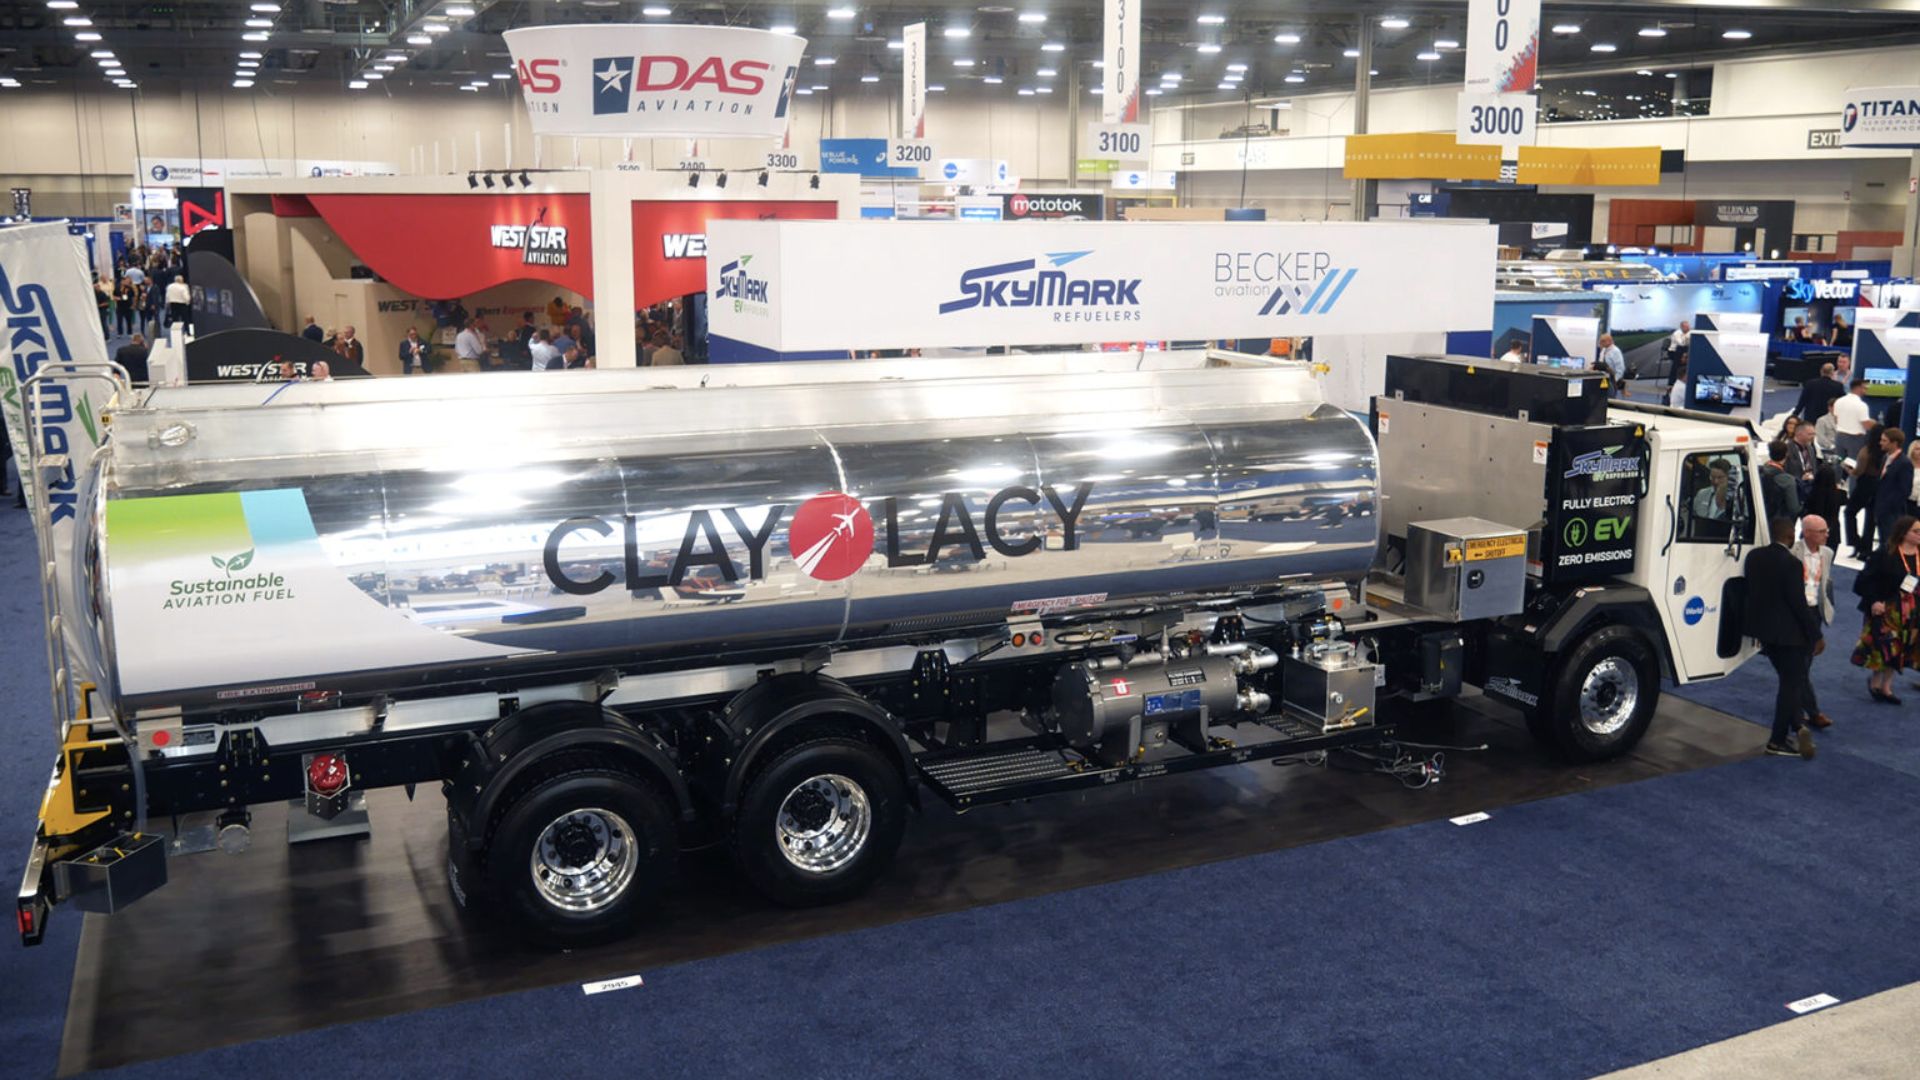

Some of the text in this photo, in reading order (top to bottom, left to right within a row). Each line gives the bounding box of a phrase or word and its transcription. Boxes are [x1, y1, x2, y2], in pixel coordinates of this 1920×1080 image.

[636, 56, 769, 96] DAS
[637, 100, 754, 115] AVIATION
[1861, 100, 1920, 117] TITAN
[1470, 106, 1524, 134] 3000
[1099, 132, 1140, 153] 3100
[767, 154, 797, 168] 3300
[896, 145, 932, 162] 3200
[1013, 198, 1082, 212] mototok
[490, 225, 567, 250] WEST STAR
[527, 252, 568, 266] AVIATION
[1215, 252, 1331, 282] BECKER
[1215, 284, 1271, 297] aviation
[1054, 311, 1142, 323] REFUELERS
[217, 362, 307, 377] WEST STR
[1563, 494, 1635, 511] FULLY ELECTRIC
[1594, 515, 1631, 541] EV
[544, 482, 1095, 595] CLAY LACY
[1558, 549, 1633, 567] ZERO EMISSIONS
[170, 571, 285, 596] Sustainable
[163, 588, 296, 610] AVIATION FUEL
